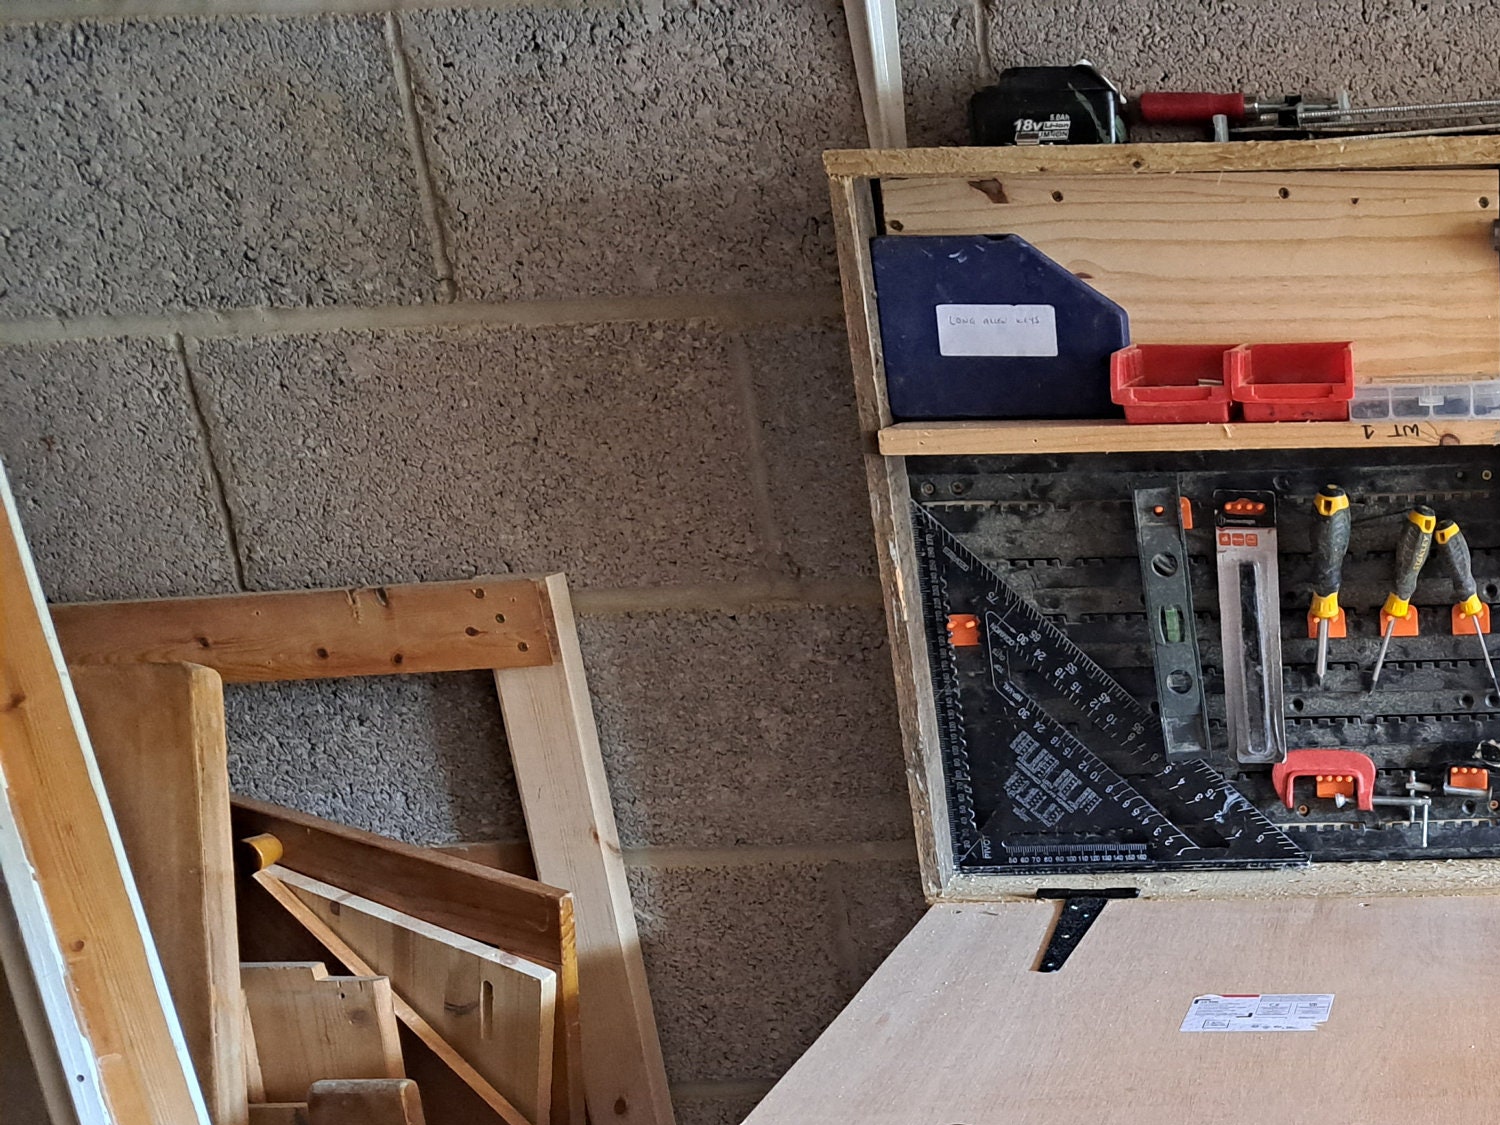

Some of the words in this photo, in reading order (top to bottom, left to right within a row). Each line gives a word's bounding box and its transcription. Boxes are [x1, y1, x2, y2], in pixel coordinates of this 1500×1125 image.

[1016, 633, 1029, 646] 30
[1033, 648, 1047, 661] 24
[1054, 667, 1067, 679] 18
[1017, 707, 1031, 720] 30
[1106, 713, 1118, 726] 10
[1033, 721, 1047, 734] 24
[1050, 736, 1061, 748] 18
[1062, 747, 1074, 759] 15
[1078, 760, 1090, 772] 12
[1089, 770, 1101, 783] 10
